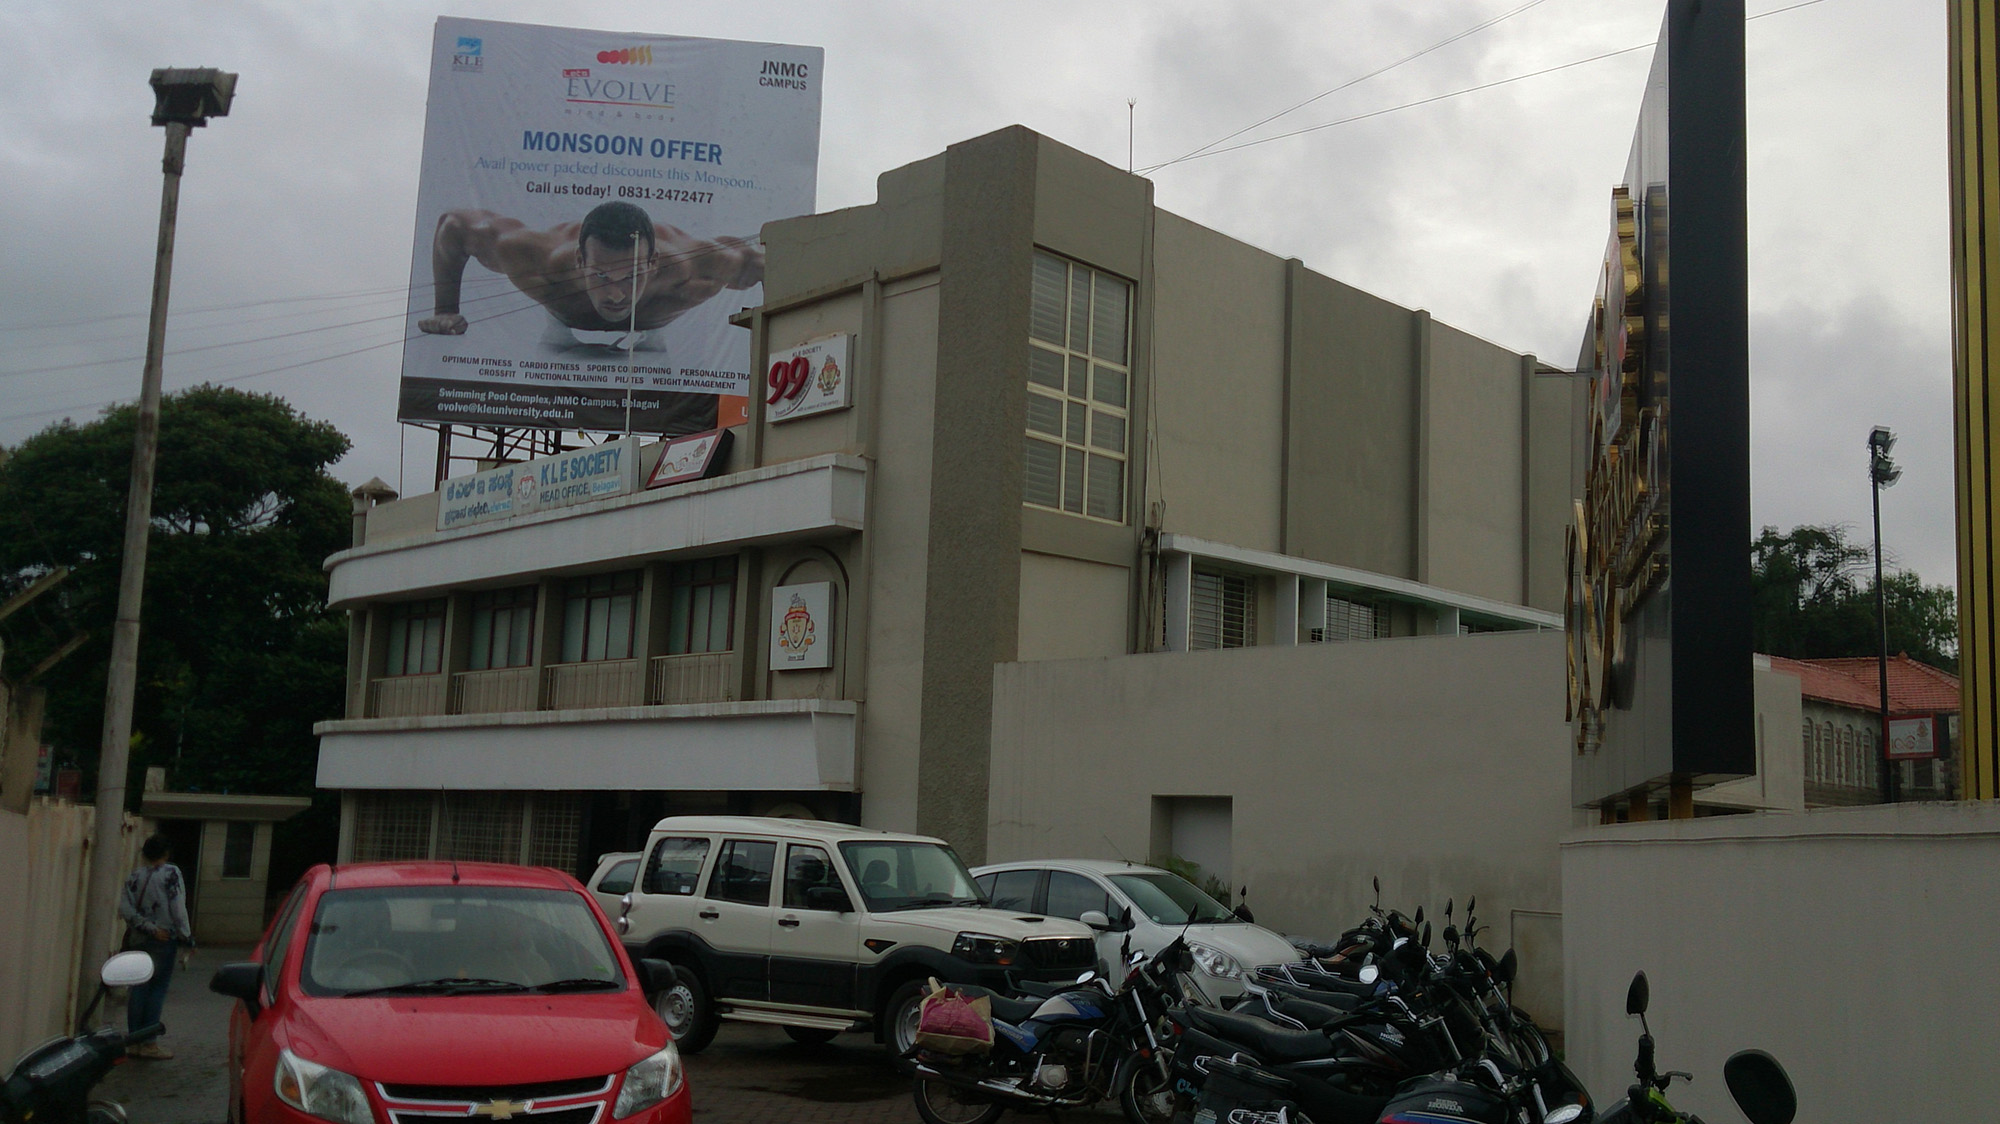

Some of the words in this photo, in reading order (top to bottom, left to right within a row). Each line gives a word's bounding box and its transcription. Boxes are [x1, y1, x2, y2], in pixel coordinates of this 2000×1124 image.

[759, 60, 809, 79] JNMC
[566, 78, 676, 104] EVOLVE
[758, 76, 808, 91] CAMPUS
[522, 130, 643, 156] MONSOON
[650, 138, 723, 166] OFFER
[474, 156, 507, 170] Avail
[509, 160, 549, 175] power
[553, 161, 598, 177] packed
[602, 162, 663, 179] discounts
[667, 168, 690, 181] this
[525, 180, 551, 194] Call
[553, 184, 569, 195] us
[571, 183, 612, 199] today!
[617, 185, 715, 205] 0831-2472477
[442, 355, 480, 365] OPTIMUM
[481, 357, 513, 368] FITNESS
[519, 360, 549, 370] CARDIO
[550, 362, 580, 371] FITNESS
[586, 364, 616, 373] SPORTS
[617, 365, 672, 375] CODITIONING
[680, 368, 736, 380] PERSONALIZED
[478, 368, 517, 378] CROSSFIT
[524, 372, 571, 382] FUNCTIONAL
[572, 374, 608, 383] TRAINING
[652, 377, 682, 387] WEIGHT
[683, 379, 736, 390] MANAGEMENT
[766, 356, 810, 405] 99
[438, 387, 487, 402] Swimming
[488, 391, 508, 401] Pool
[509, 392, 551, 405] Complex,
[552, 395, 579, 406] JNMC
[580, 396, 620, 409] Campus,
[437, 402, 574, 420] evolve@kleuniversity.edu.in
[570, 448, 621, 479] SOCIETY
[540, 488, 560, 504] HEAD
[561, 482, 591, 500] OFFICE,
[1427, 1101, 1464, 1113] HONDA
